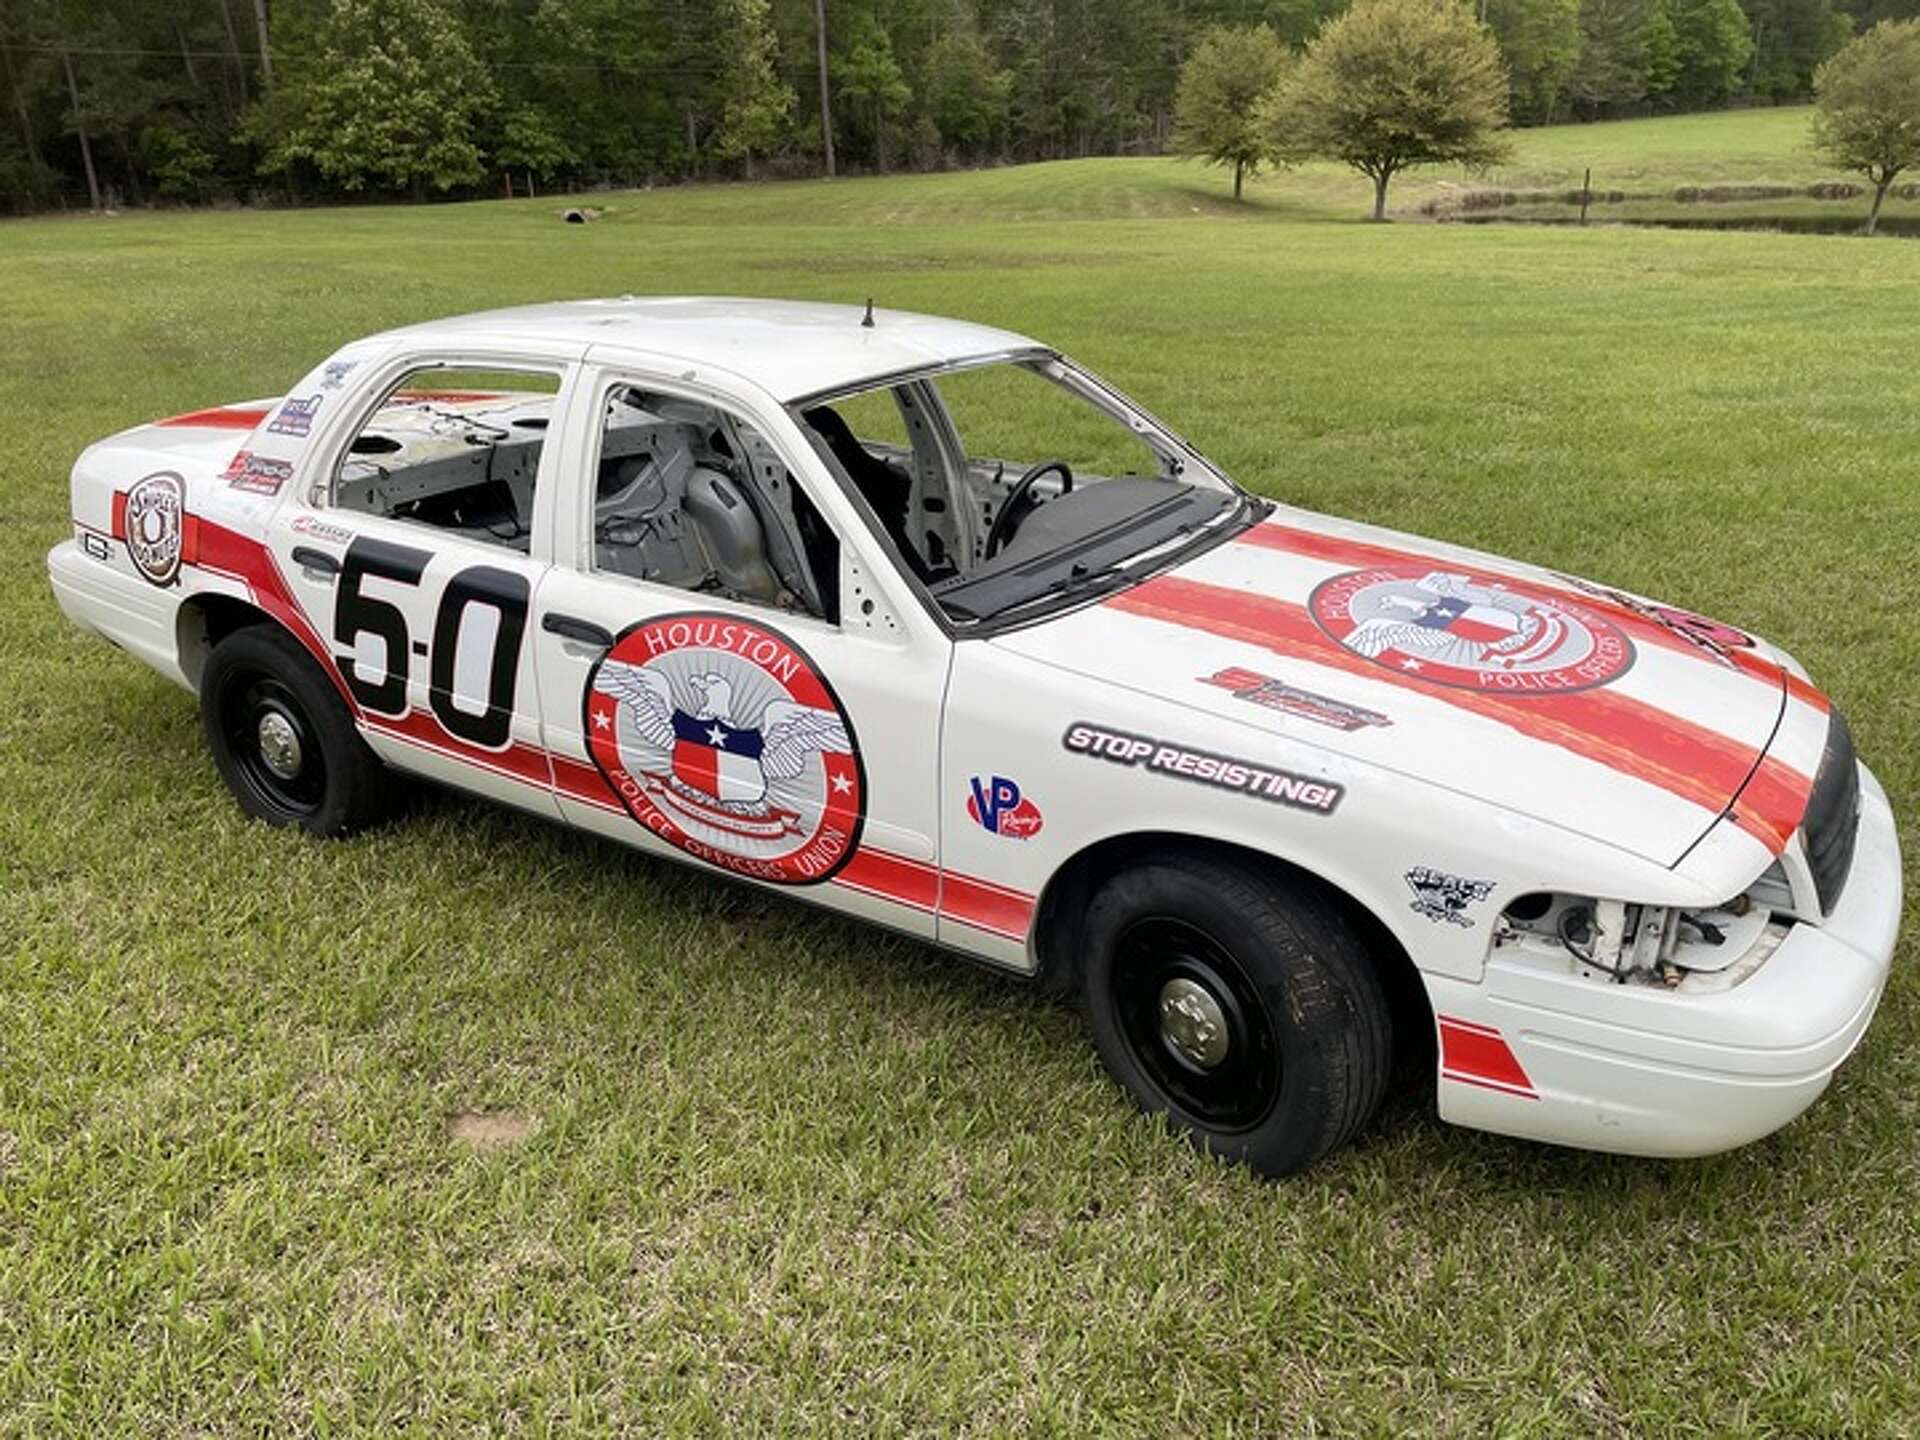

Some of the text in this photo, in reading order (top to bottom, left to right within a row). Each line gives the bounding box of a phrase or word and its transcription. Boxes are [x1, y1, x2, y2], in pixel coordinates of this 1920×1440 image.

[645, 622, 801, 684] HOUSTON
[1479, 671, 1577, 689] POLICE
[1067, 726, 1338, 810] STOP RESISTING!
[611, 769, 674, 838] POLICE
[794, 823, 846, 877] UNION
[970, 775, 1020, 834] VP
